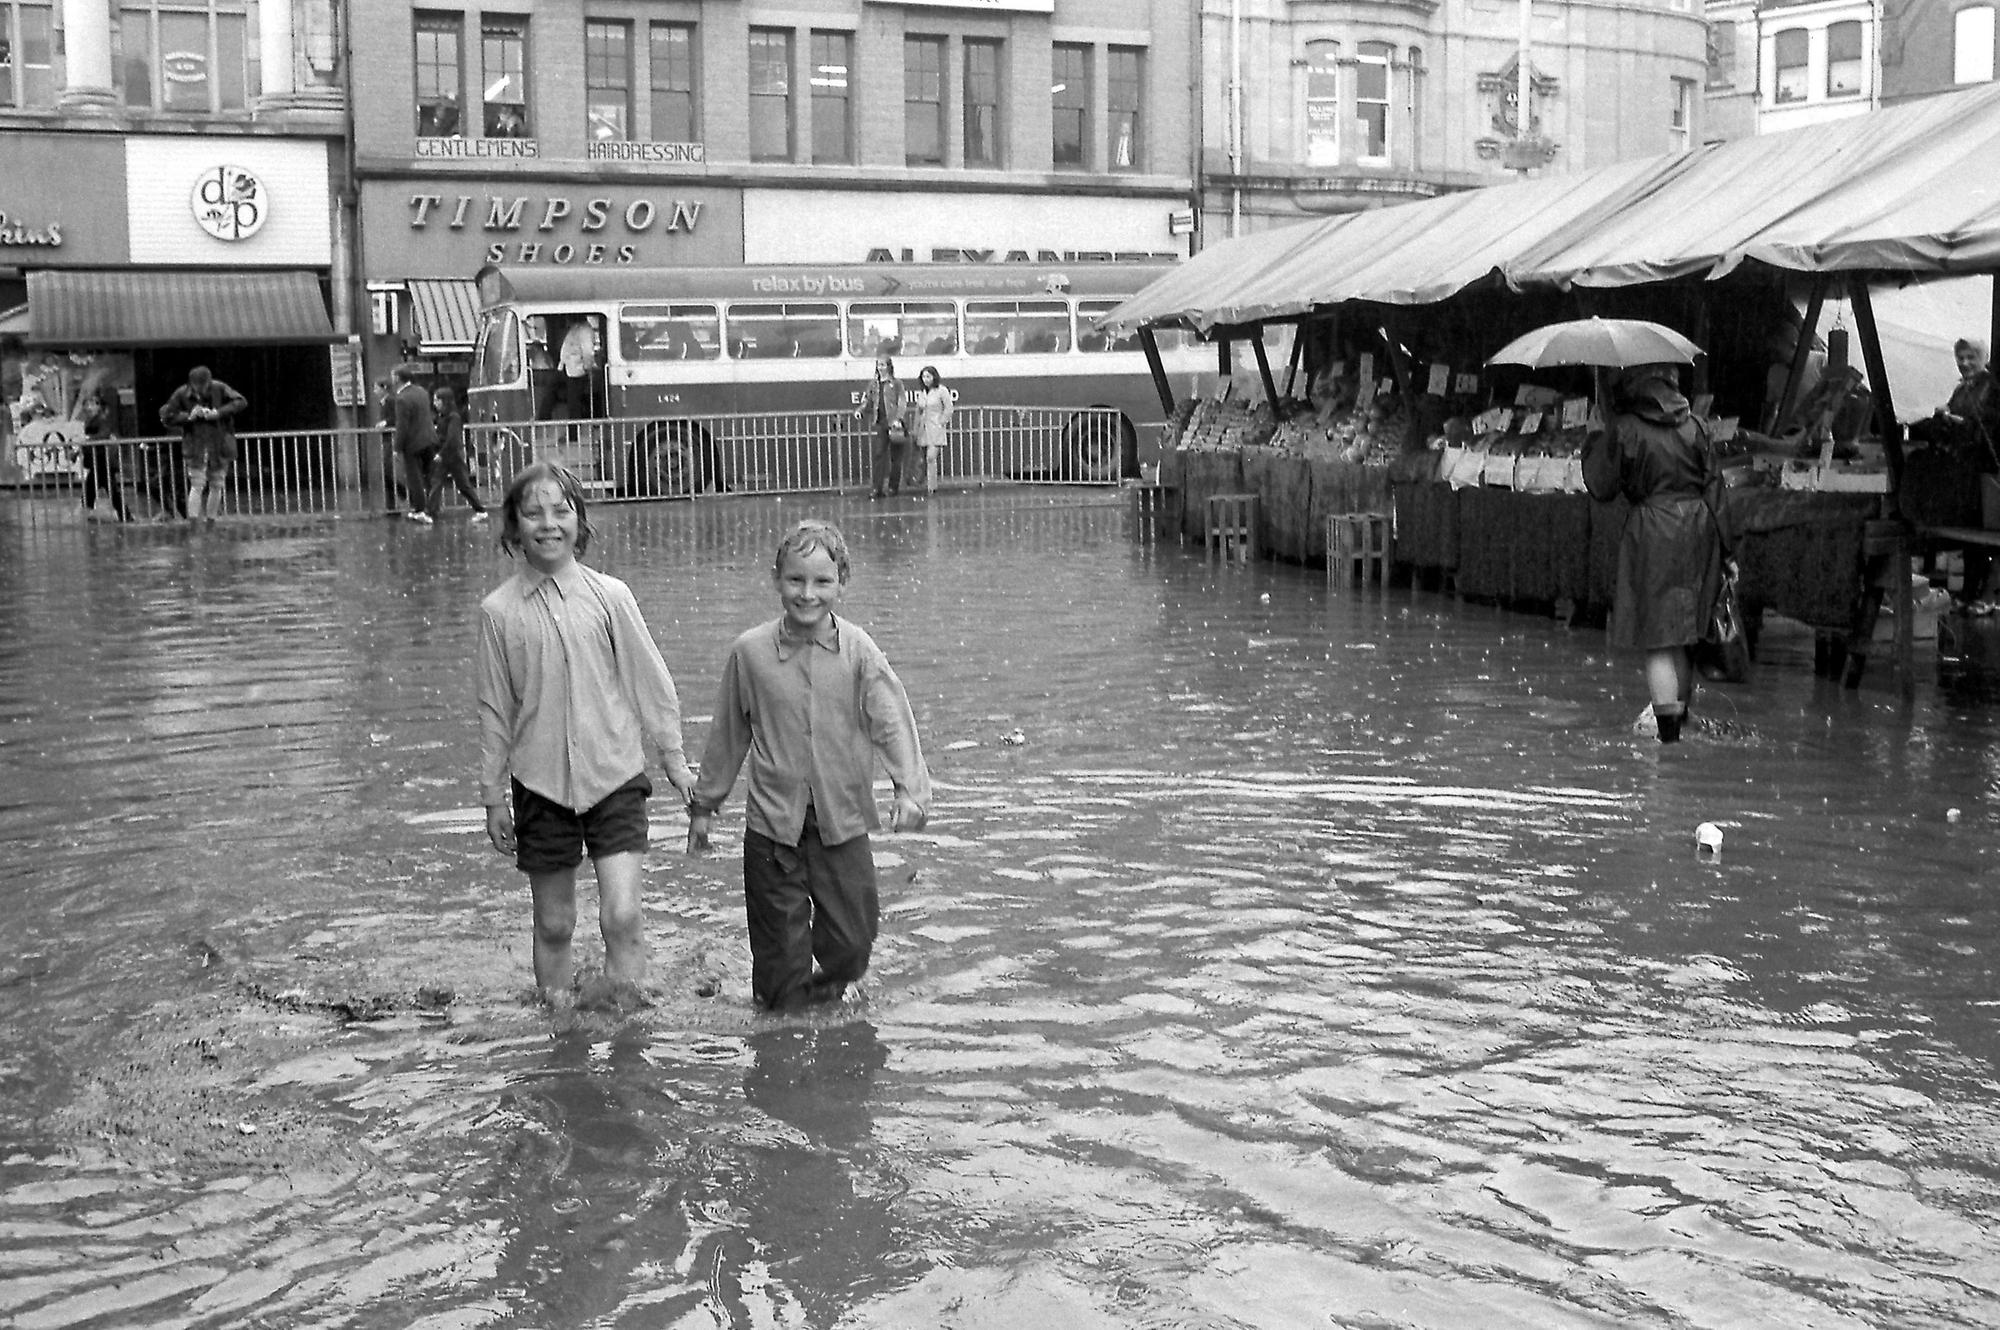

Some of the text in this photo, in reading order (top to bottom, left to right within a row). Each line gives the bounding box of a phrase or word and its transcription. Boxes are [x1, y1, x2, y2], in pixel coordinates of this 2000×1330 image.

[415, 139, 538, 158] GENTLEMENS
[587, 142, 702, 162] HAIRDRESSING
[409, 194, 704, 232] TIMPSON
[486, 241, 636, 266] SHOES
[752, 274, 864, 295] relax by bus
